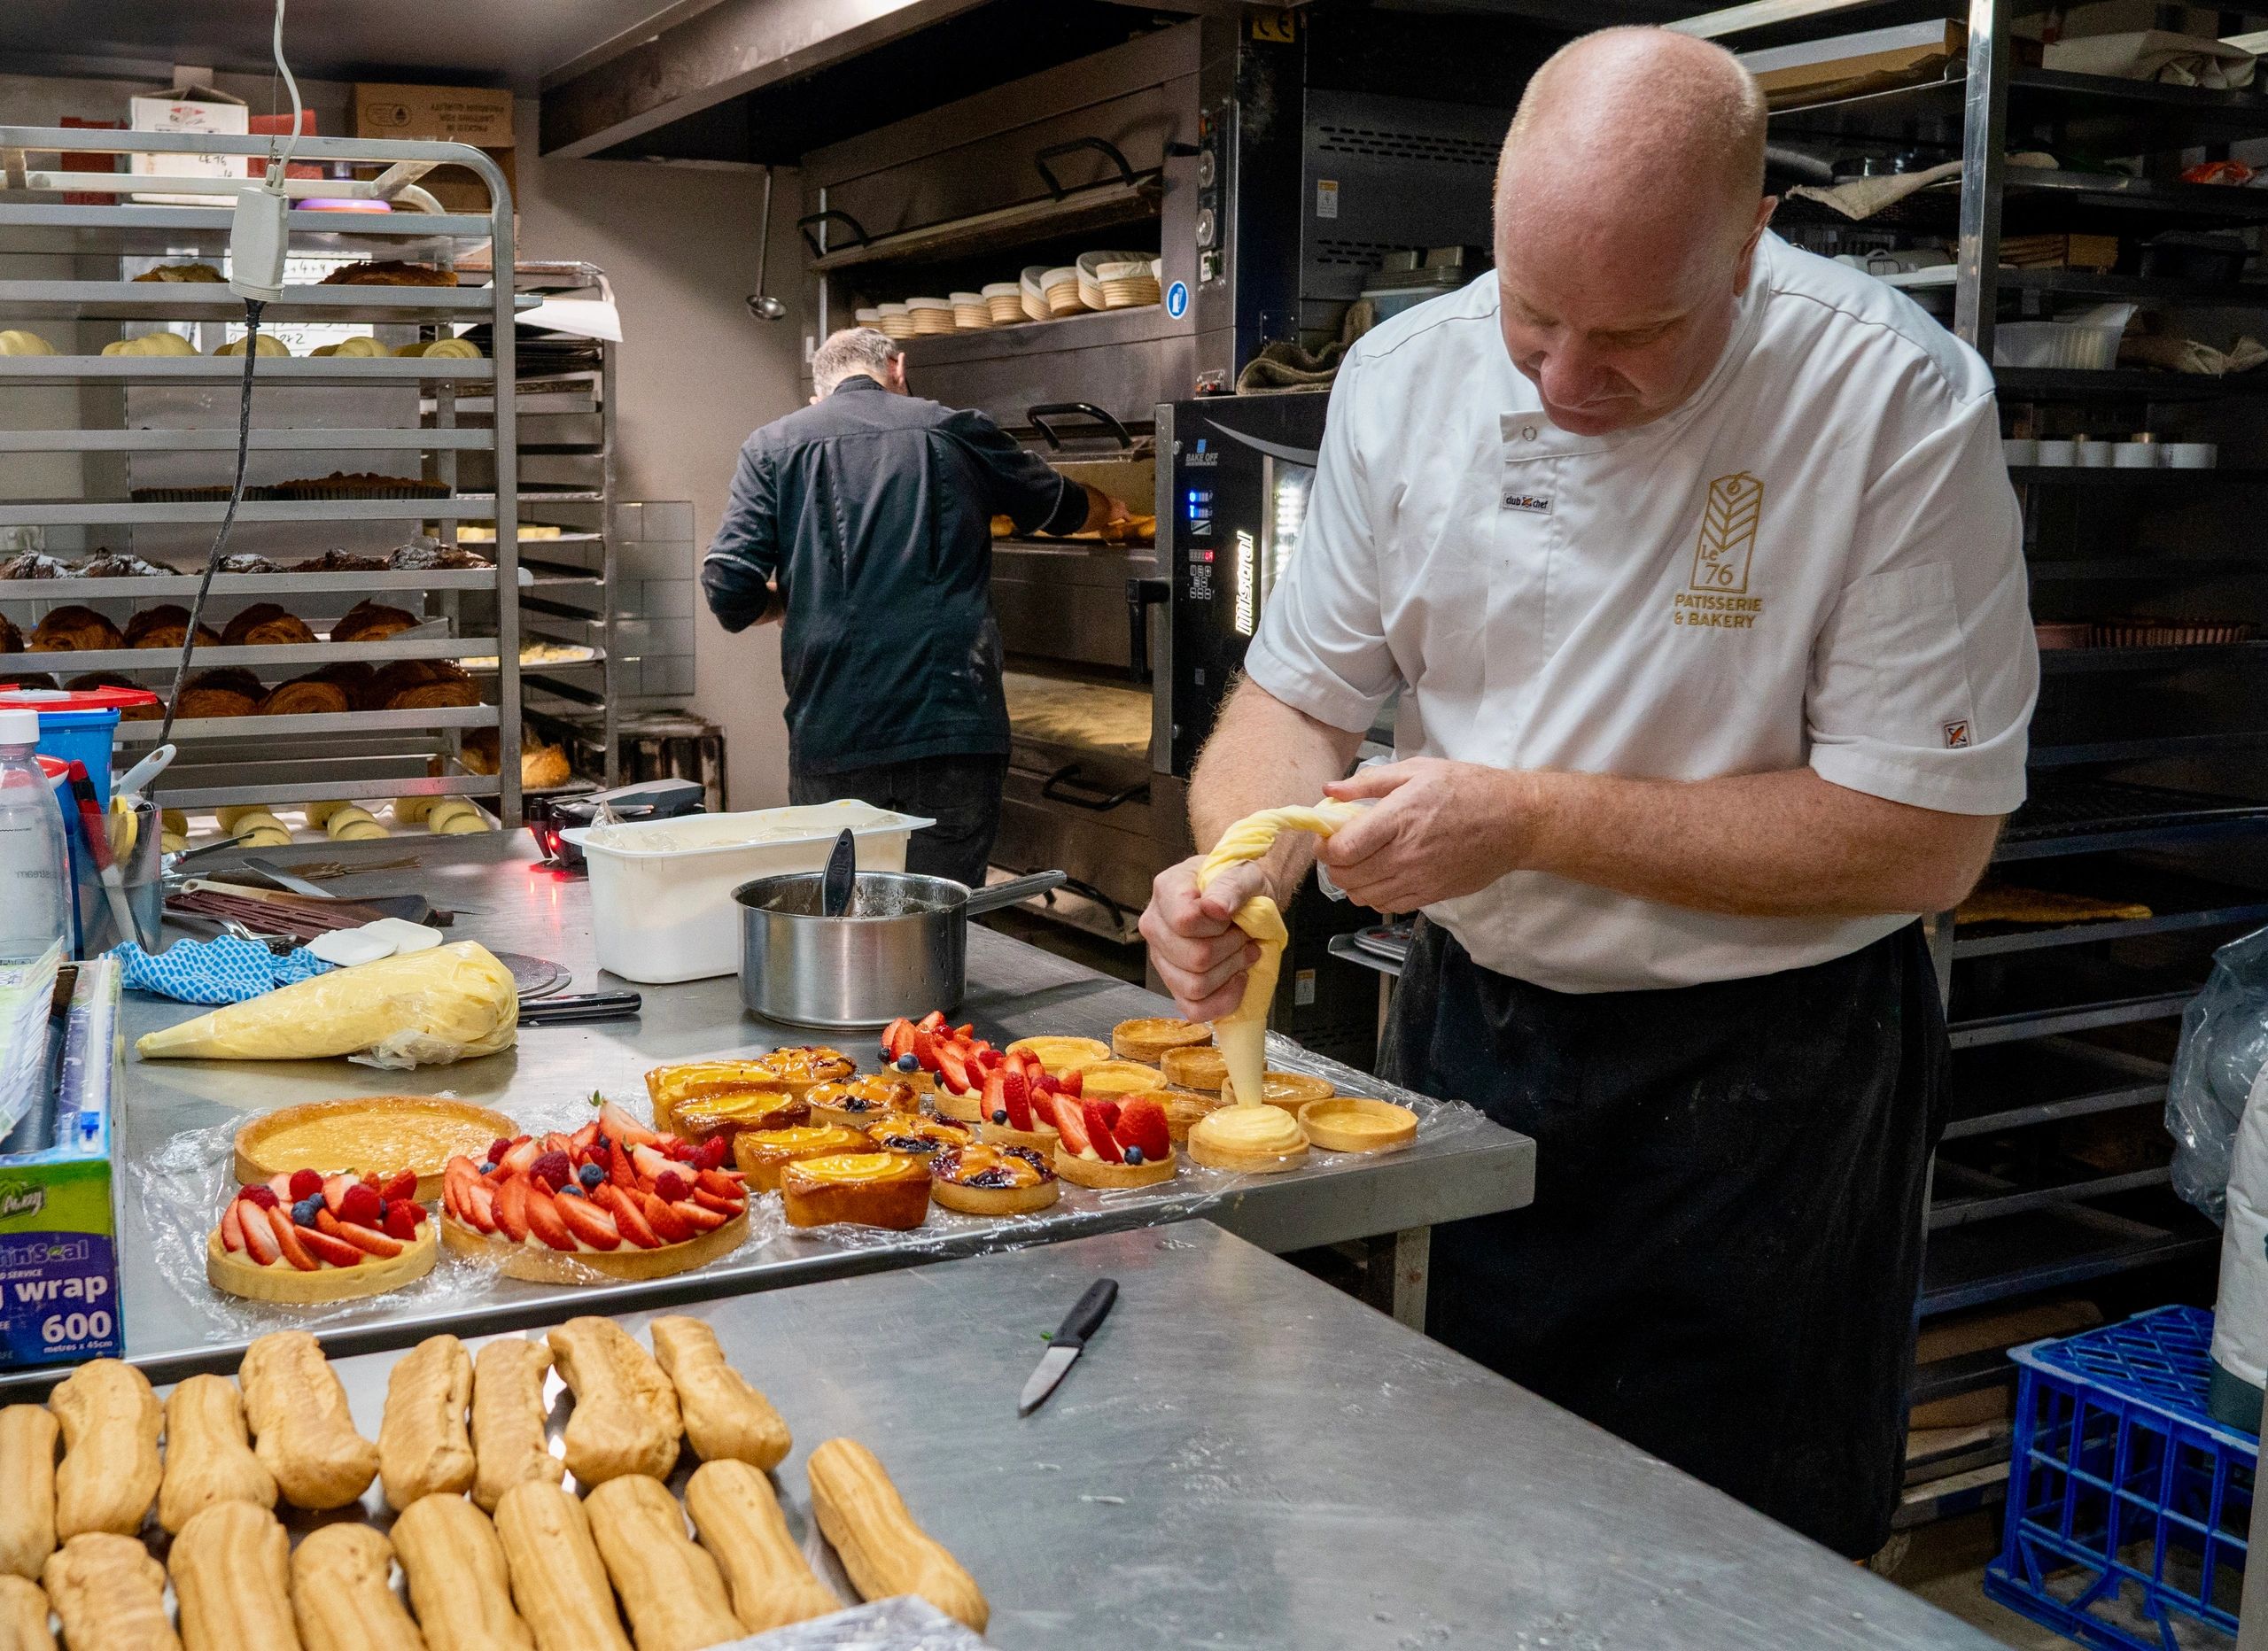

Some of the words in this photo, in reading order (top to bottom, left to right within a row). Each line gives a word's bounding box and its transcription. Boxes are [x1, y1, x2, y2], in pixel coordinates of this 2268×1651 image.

[1533, 500, 1549, 509] chef
[1701, 544, 1719, 561] Le
[1705, 562, 1733, 585] 76
[1674, 593, 1762, 611] PATISSERIE
[1674, 611, 1683, 625] &
[1688, 613, 1756, 628] BAKERY
[14, 1275, 108, 1304] wrap
[42, 1310, 112, 1344] 600
